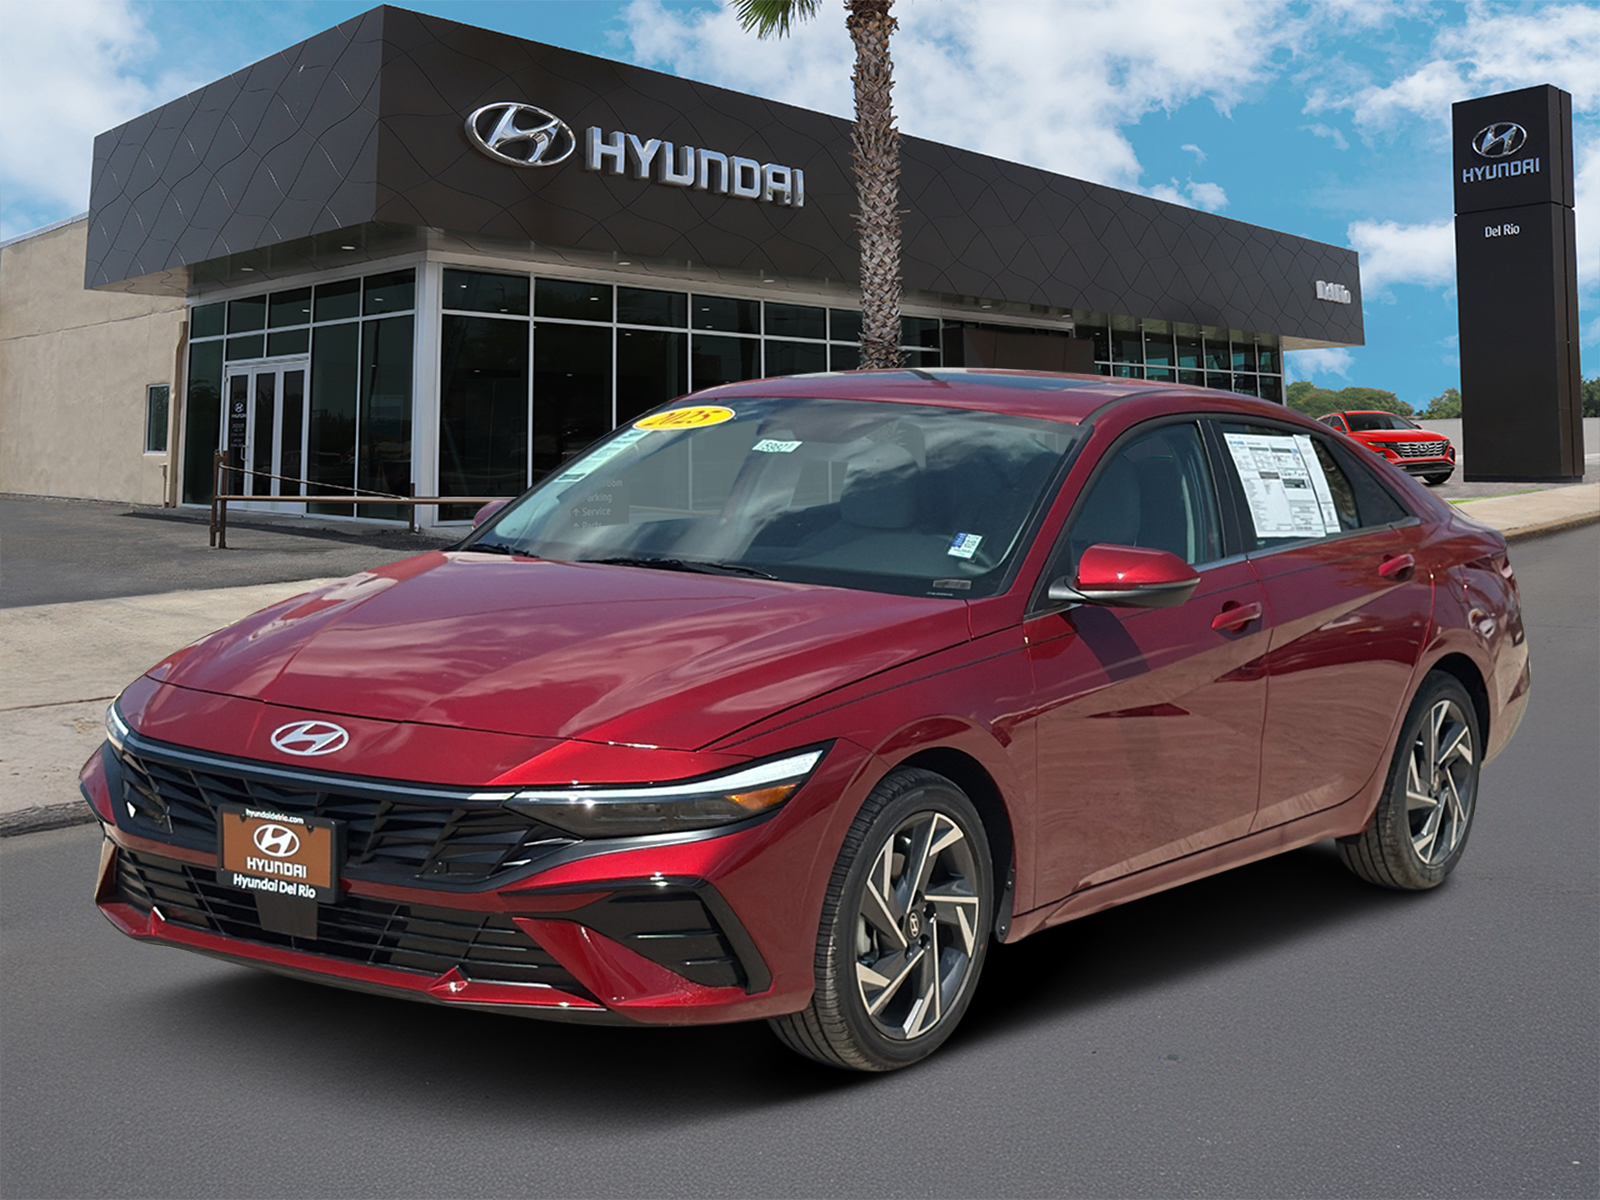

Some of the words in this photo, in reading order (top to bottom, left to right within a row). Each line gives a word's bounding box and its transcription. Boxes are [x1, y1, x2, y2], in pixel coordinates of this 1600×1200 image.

[586, 126, 804, 208] HYUNDAI
[1462, 157, 1540, 183] HYUNDAI
[1485, 225, 1501, 238] Del
[1503, 223, 1520, 235] Rio
[586, 493, 612, 503] arking
[582, 507, 611, 517] Service
[246, 808, 304, 824] hyundaidelrio.com
[246, 856, 307, 878] HYUNDAI
[233, 873, 278, 892] Hyundai
[279, 881, 296, 895] Del
[298, 885, 316, 899] Rio
